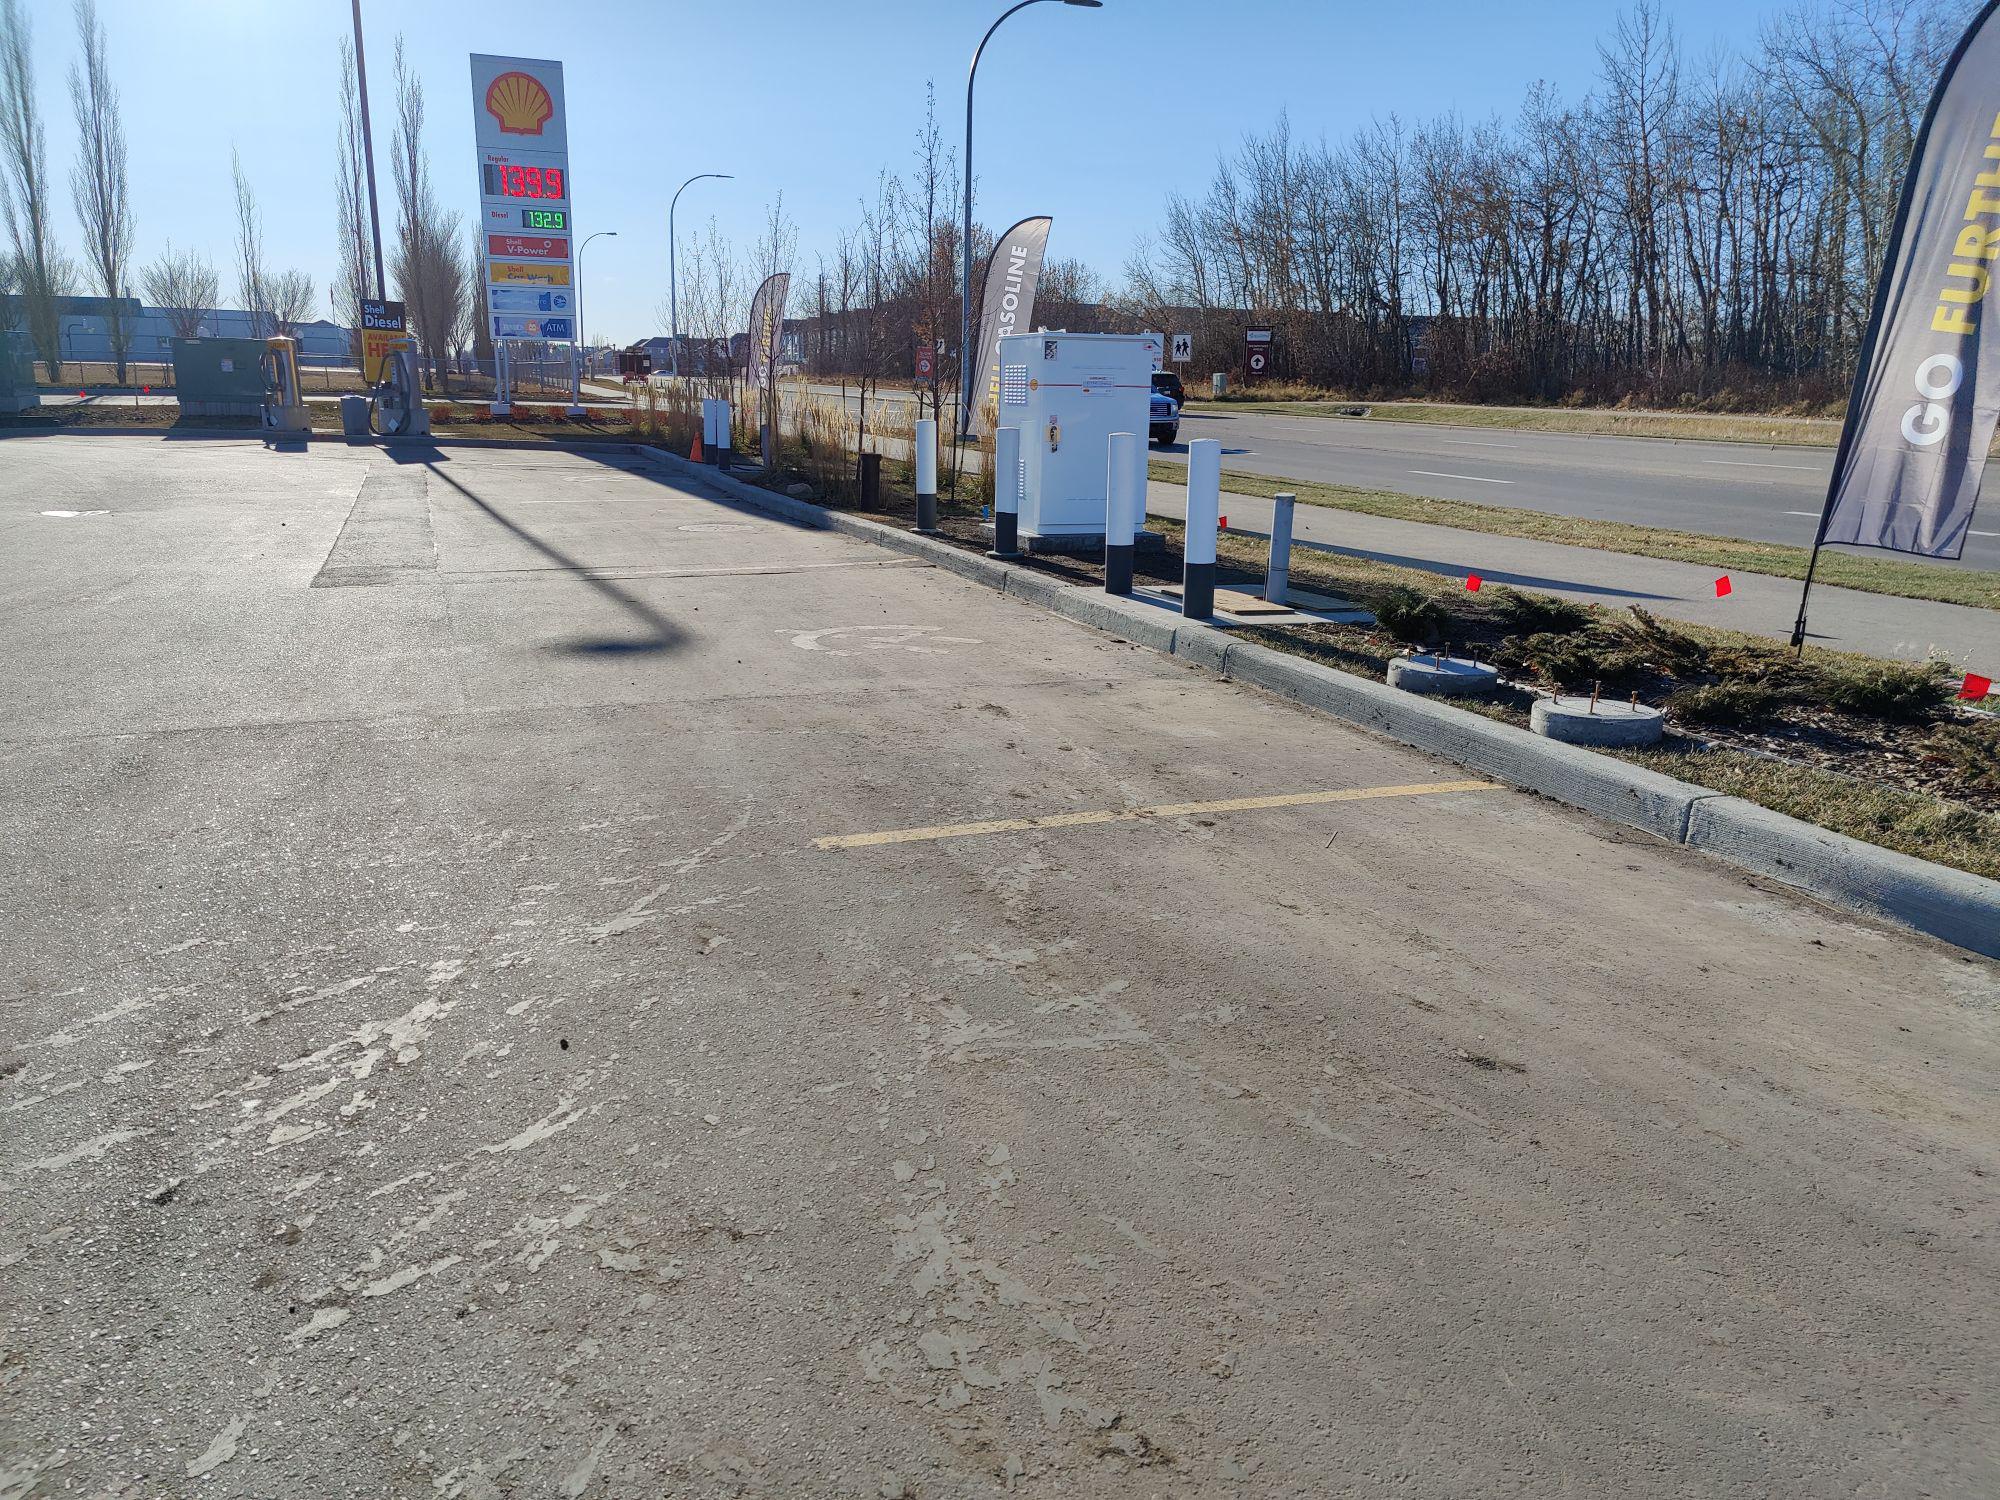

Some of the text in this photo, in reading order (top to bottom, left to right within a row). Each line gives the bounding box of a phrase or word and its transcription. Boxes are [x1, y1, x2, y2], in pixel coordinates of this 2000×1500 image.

[487, 154, 509, 164] Regular
[491, 211, 509, 219] Diesel
[529, 211, 563, 229] 132.9
[506, 246, 549, 255] V-Power
[1900, 111, 2000, 446] GO FURTH
[364, 304, 385, 315] Shell
[364, 314, 402, 329] Diesel
[546, 323, 565, 333] ATM
